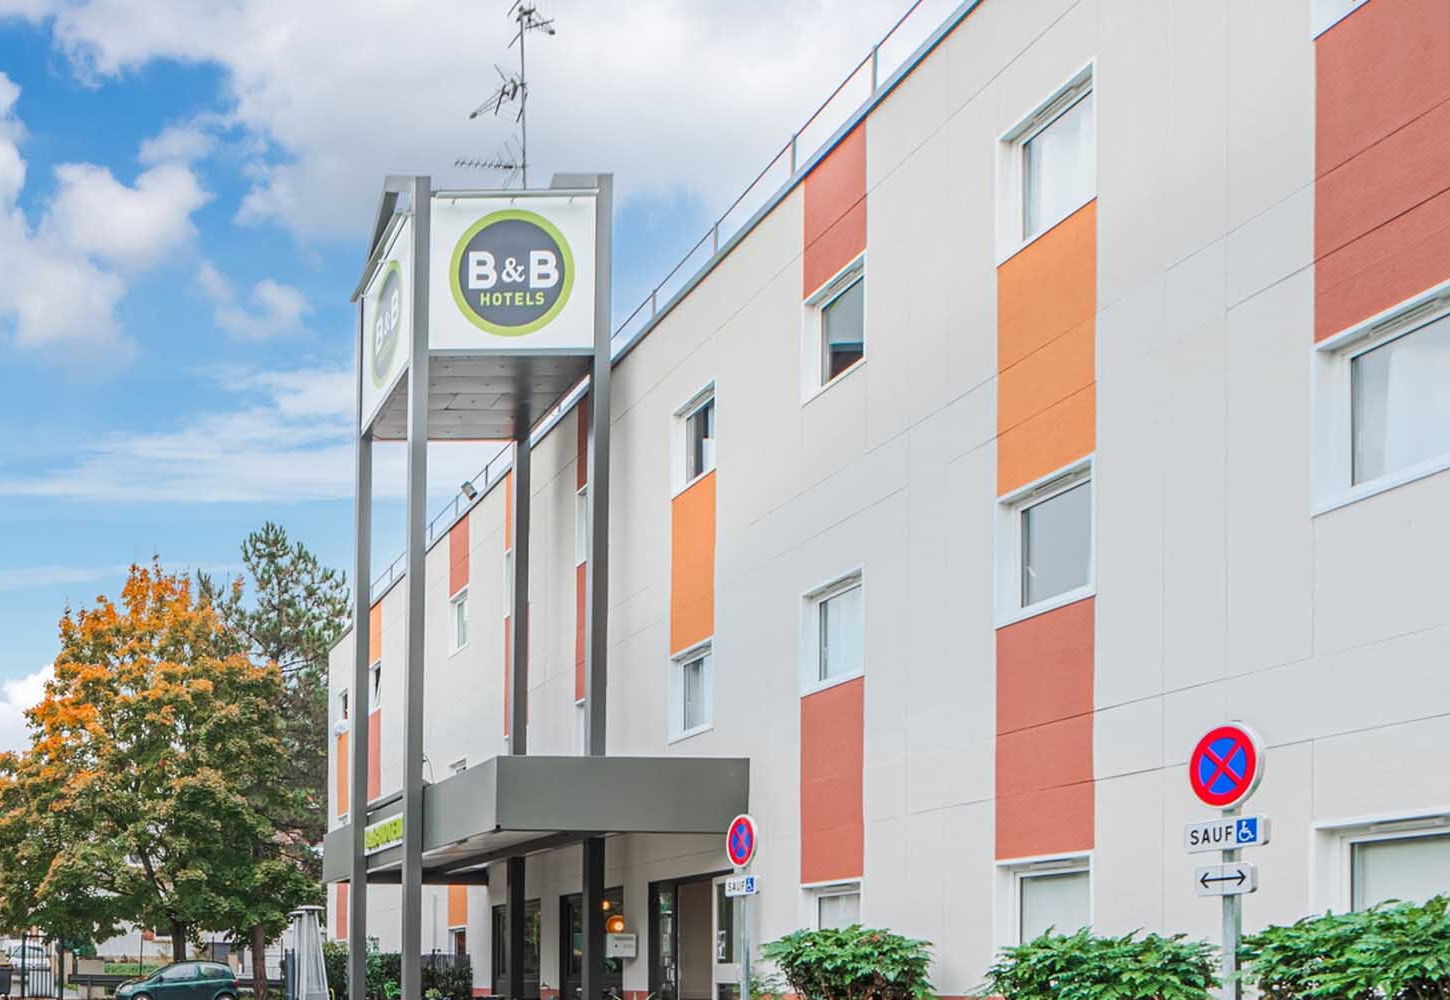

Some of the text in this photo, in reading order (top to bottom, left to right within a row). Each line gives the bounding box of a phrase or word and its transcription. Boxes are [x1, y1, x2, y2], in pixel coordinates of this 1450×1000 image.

[468, 250, 559, 289] B&B
[480, 291, 545, 307] HOTELS
[1190, 825, 1234, 846] SAUF
